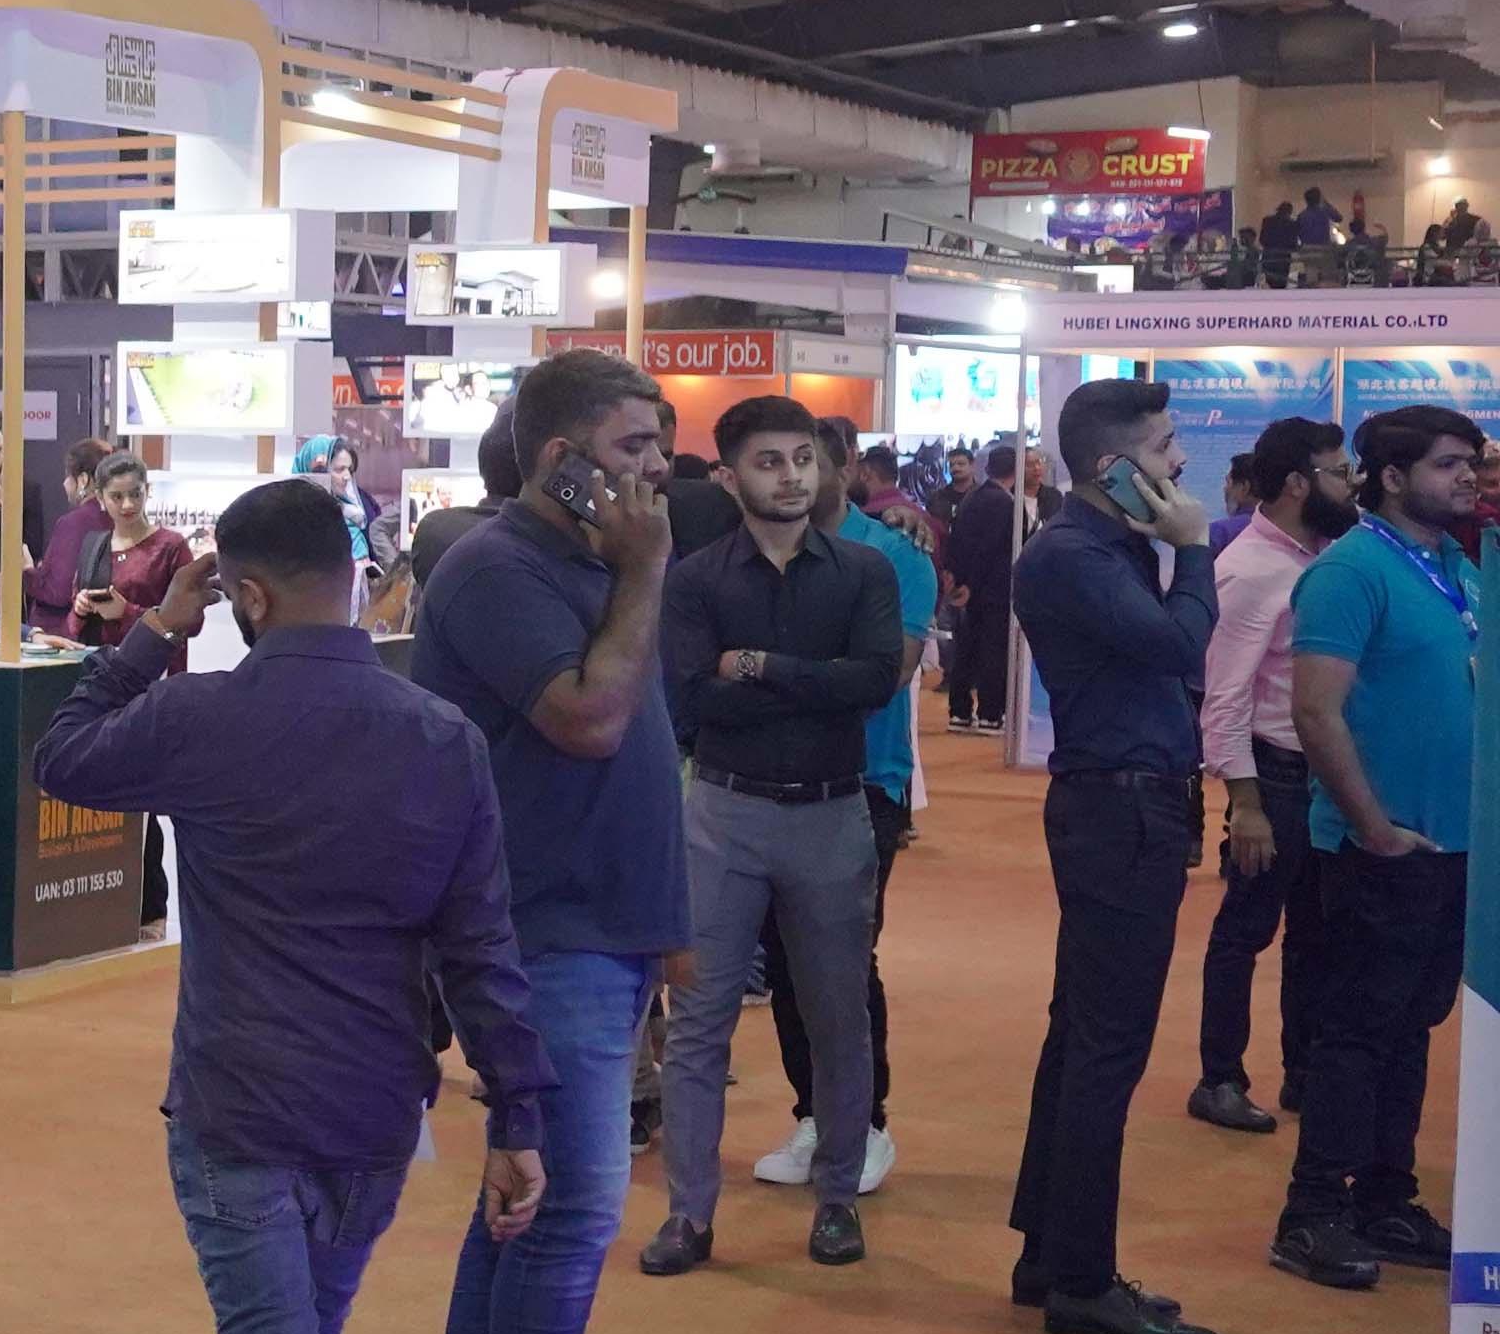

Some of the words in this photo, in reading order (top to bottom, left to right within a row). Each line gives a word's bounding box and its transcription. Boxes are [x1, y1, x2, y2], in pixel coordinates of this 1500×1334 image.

[106, 78, 122, 103] BIN
[124, 80, 156, 107] AHSAN
[981, 155, 1058, 179] PIZZA
[1102, 153, 1195, 177] CRUST
[1063, 316, 1111, 330] HUBEI
[1116, 316, 1191, 330] LINGXING
[1196, 315, 1292, 329] SUPERHARD
[1299, 315, 1380, 329] MATERIAL
[643, 338, 671, 367] t's
[676, 343, 718, 367] our
[720, 335, 767, 375] job.
[39, 799, 68, 841] BIN
[36, 882, 60, 902] UAN:
[62, 878, 75, 897] 03
[77, 876, 87, 894] 111
[90, 873, 104, 891] 155
[106, 869, 123, 888] 530
